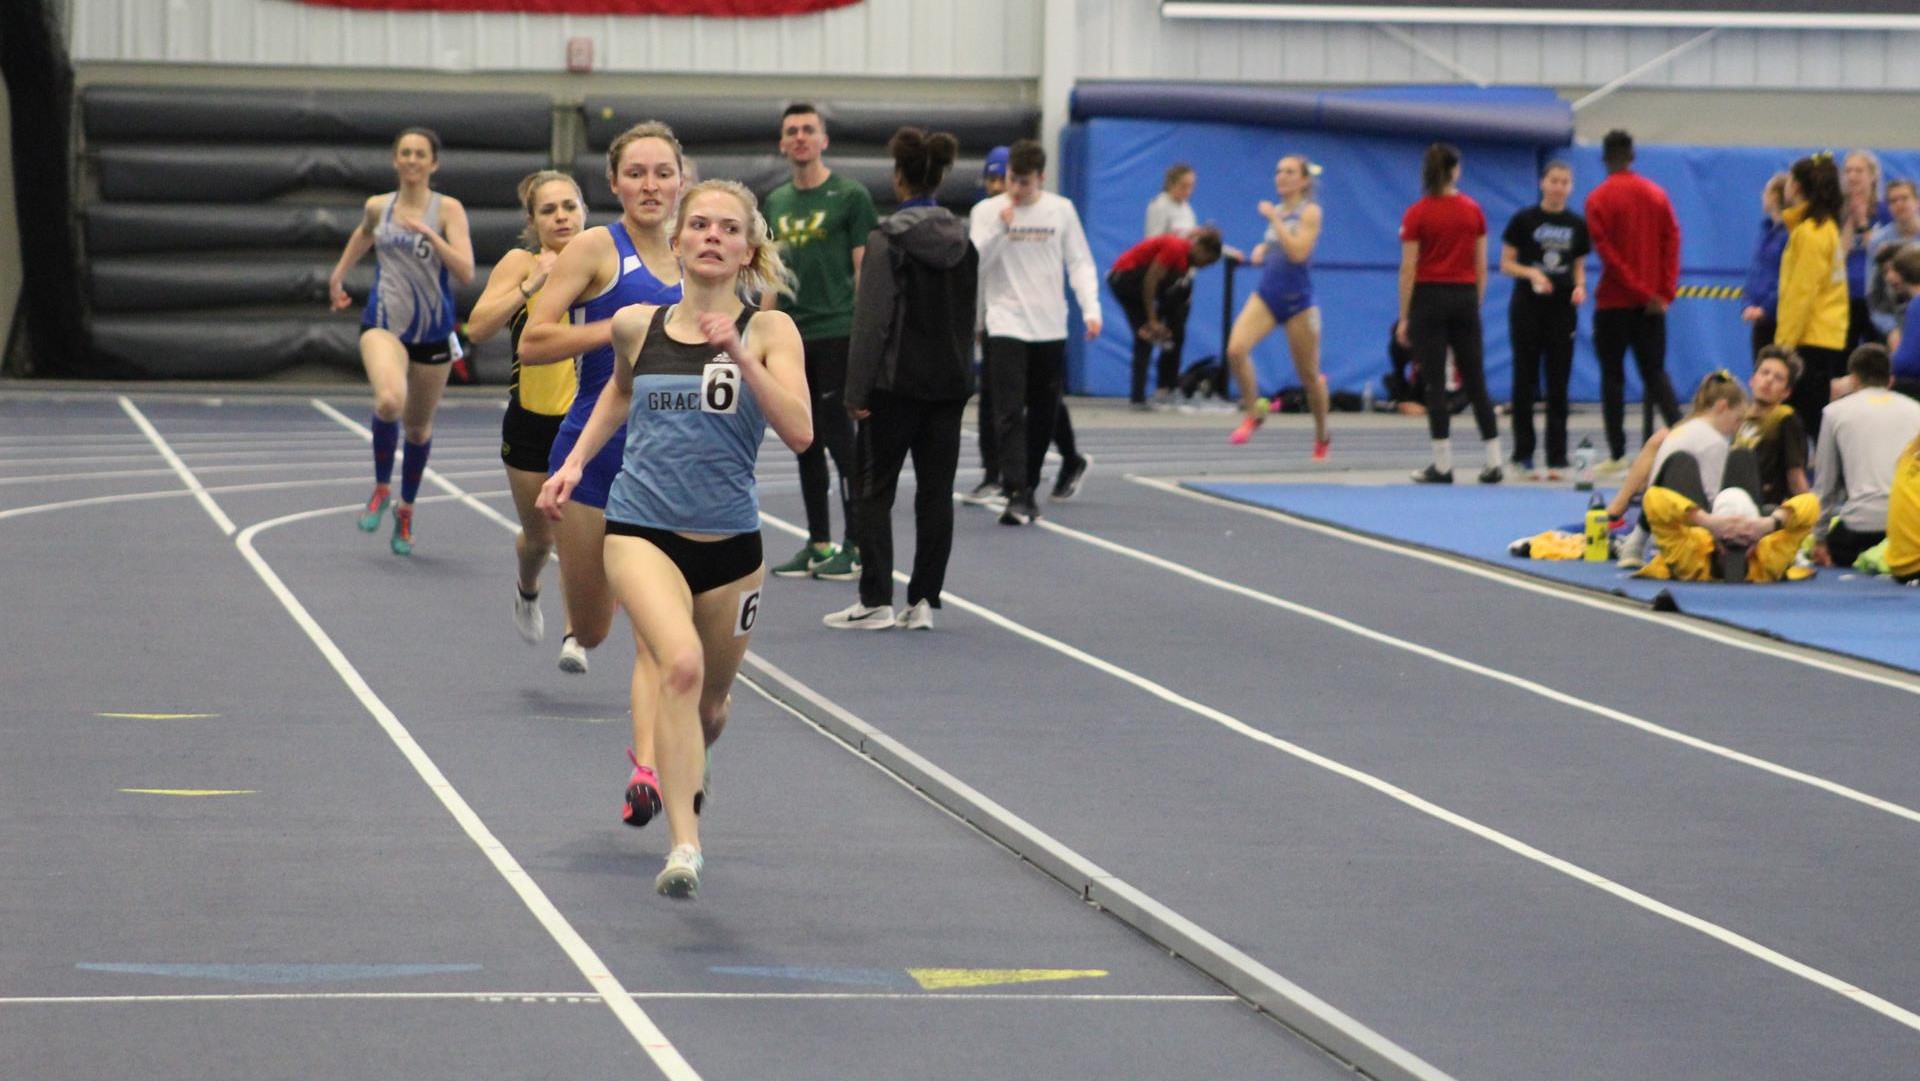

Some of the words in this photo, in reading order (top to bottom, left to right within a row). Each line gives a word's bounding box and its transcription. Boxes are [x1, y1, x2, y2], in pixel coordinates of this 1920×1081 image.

[416, 235, 430, 259] 5
[648, 392, 702, 410] GRAC
[706, 367, 734, 411] 6
[741, 591, 759, 631] 6
